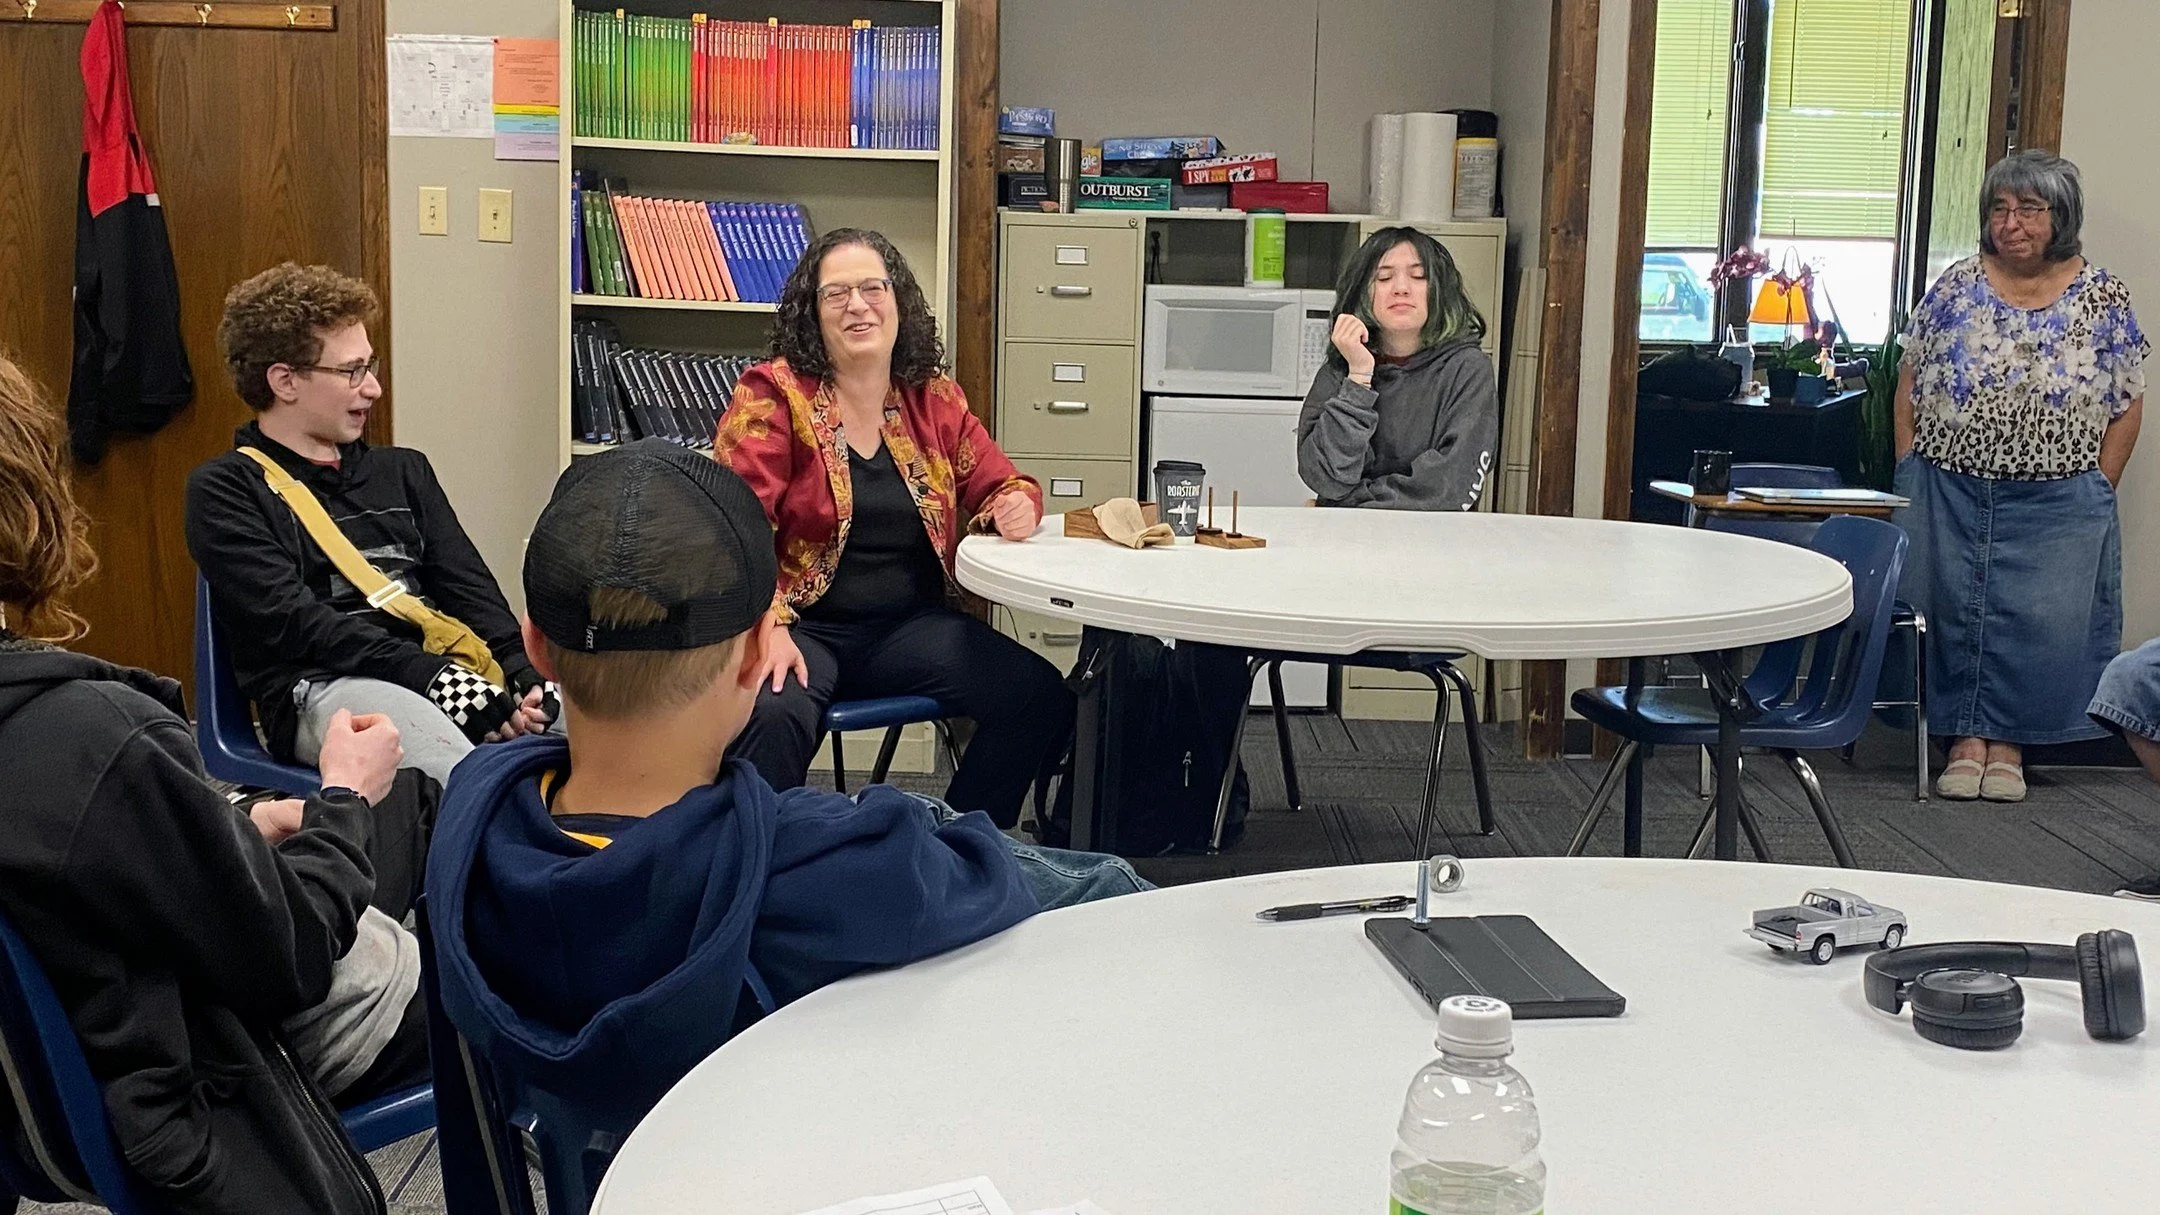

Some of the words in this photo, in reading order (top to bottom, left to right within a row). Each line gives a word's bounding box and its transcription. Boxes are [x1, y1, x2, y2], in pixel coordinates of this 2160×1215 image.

[1080, 154, 1097, 170] gle
[1188, 171, 1192, 184] I
[1194, 170, 1210, 183] SPY
[1080, 184, 1152, 197] OUTBURST
